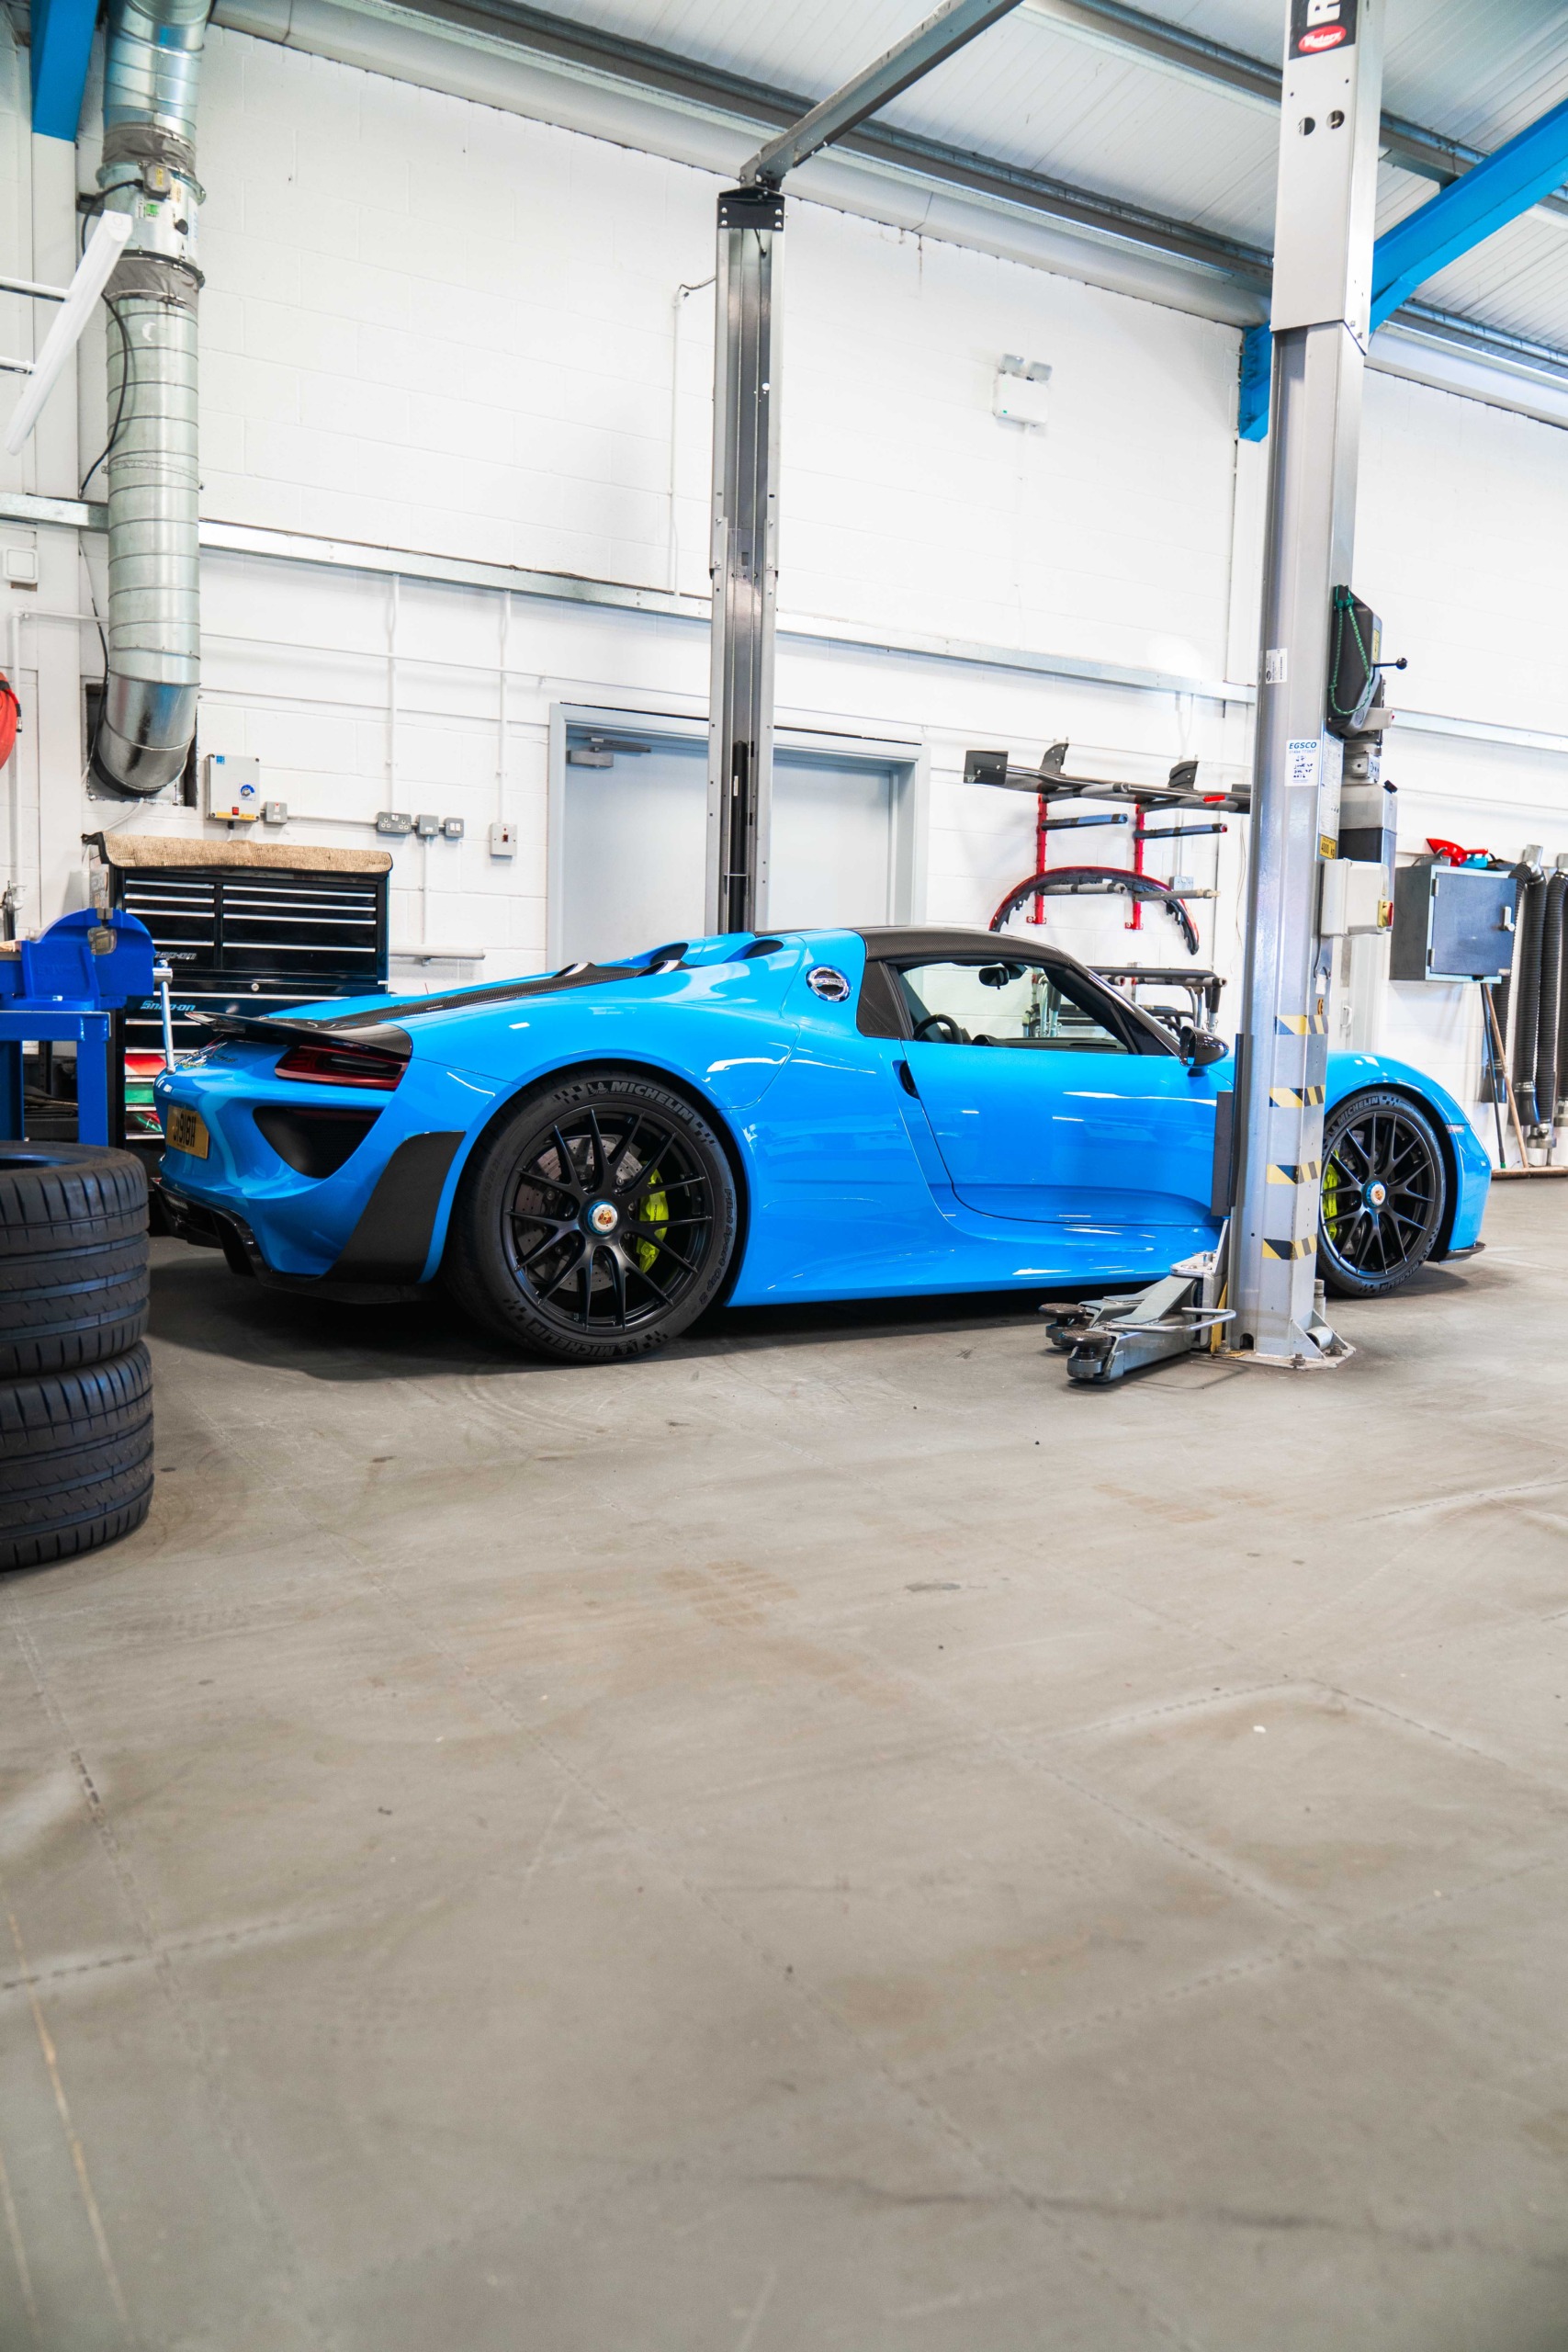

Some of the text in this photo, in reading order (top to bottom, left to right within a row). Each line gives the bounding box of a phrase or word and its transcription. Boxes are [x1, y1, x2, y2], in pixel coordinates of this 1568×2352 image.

[1289, 741, 1317, 750] EGSCO
[154, 952, 197, 961] nap-on
[140, 1000, 196, 1012] Snp-on
[610, 1081, 694, 1121] MICHELIN
[1337, 1096, 1379, 1125] MICHELIN
[724, 1188, 734, 1224] Pilot
[718, 1225, 733, 1267] Sport
[706, 1267, 722, 1292] Cup
[527, 1320, 616, 1357] MICHELIN
